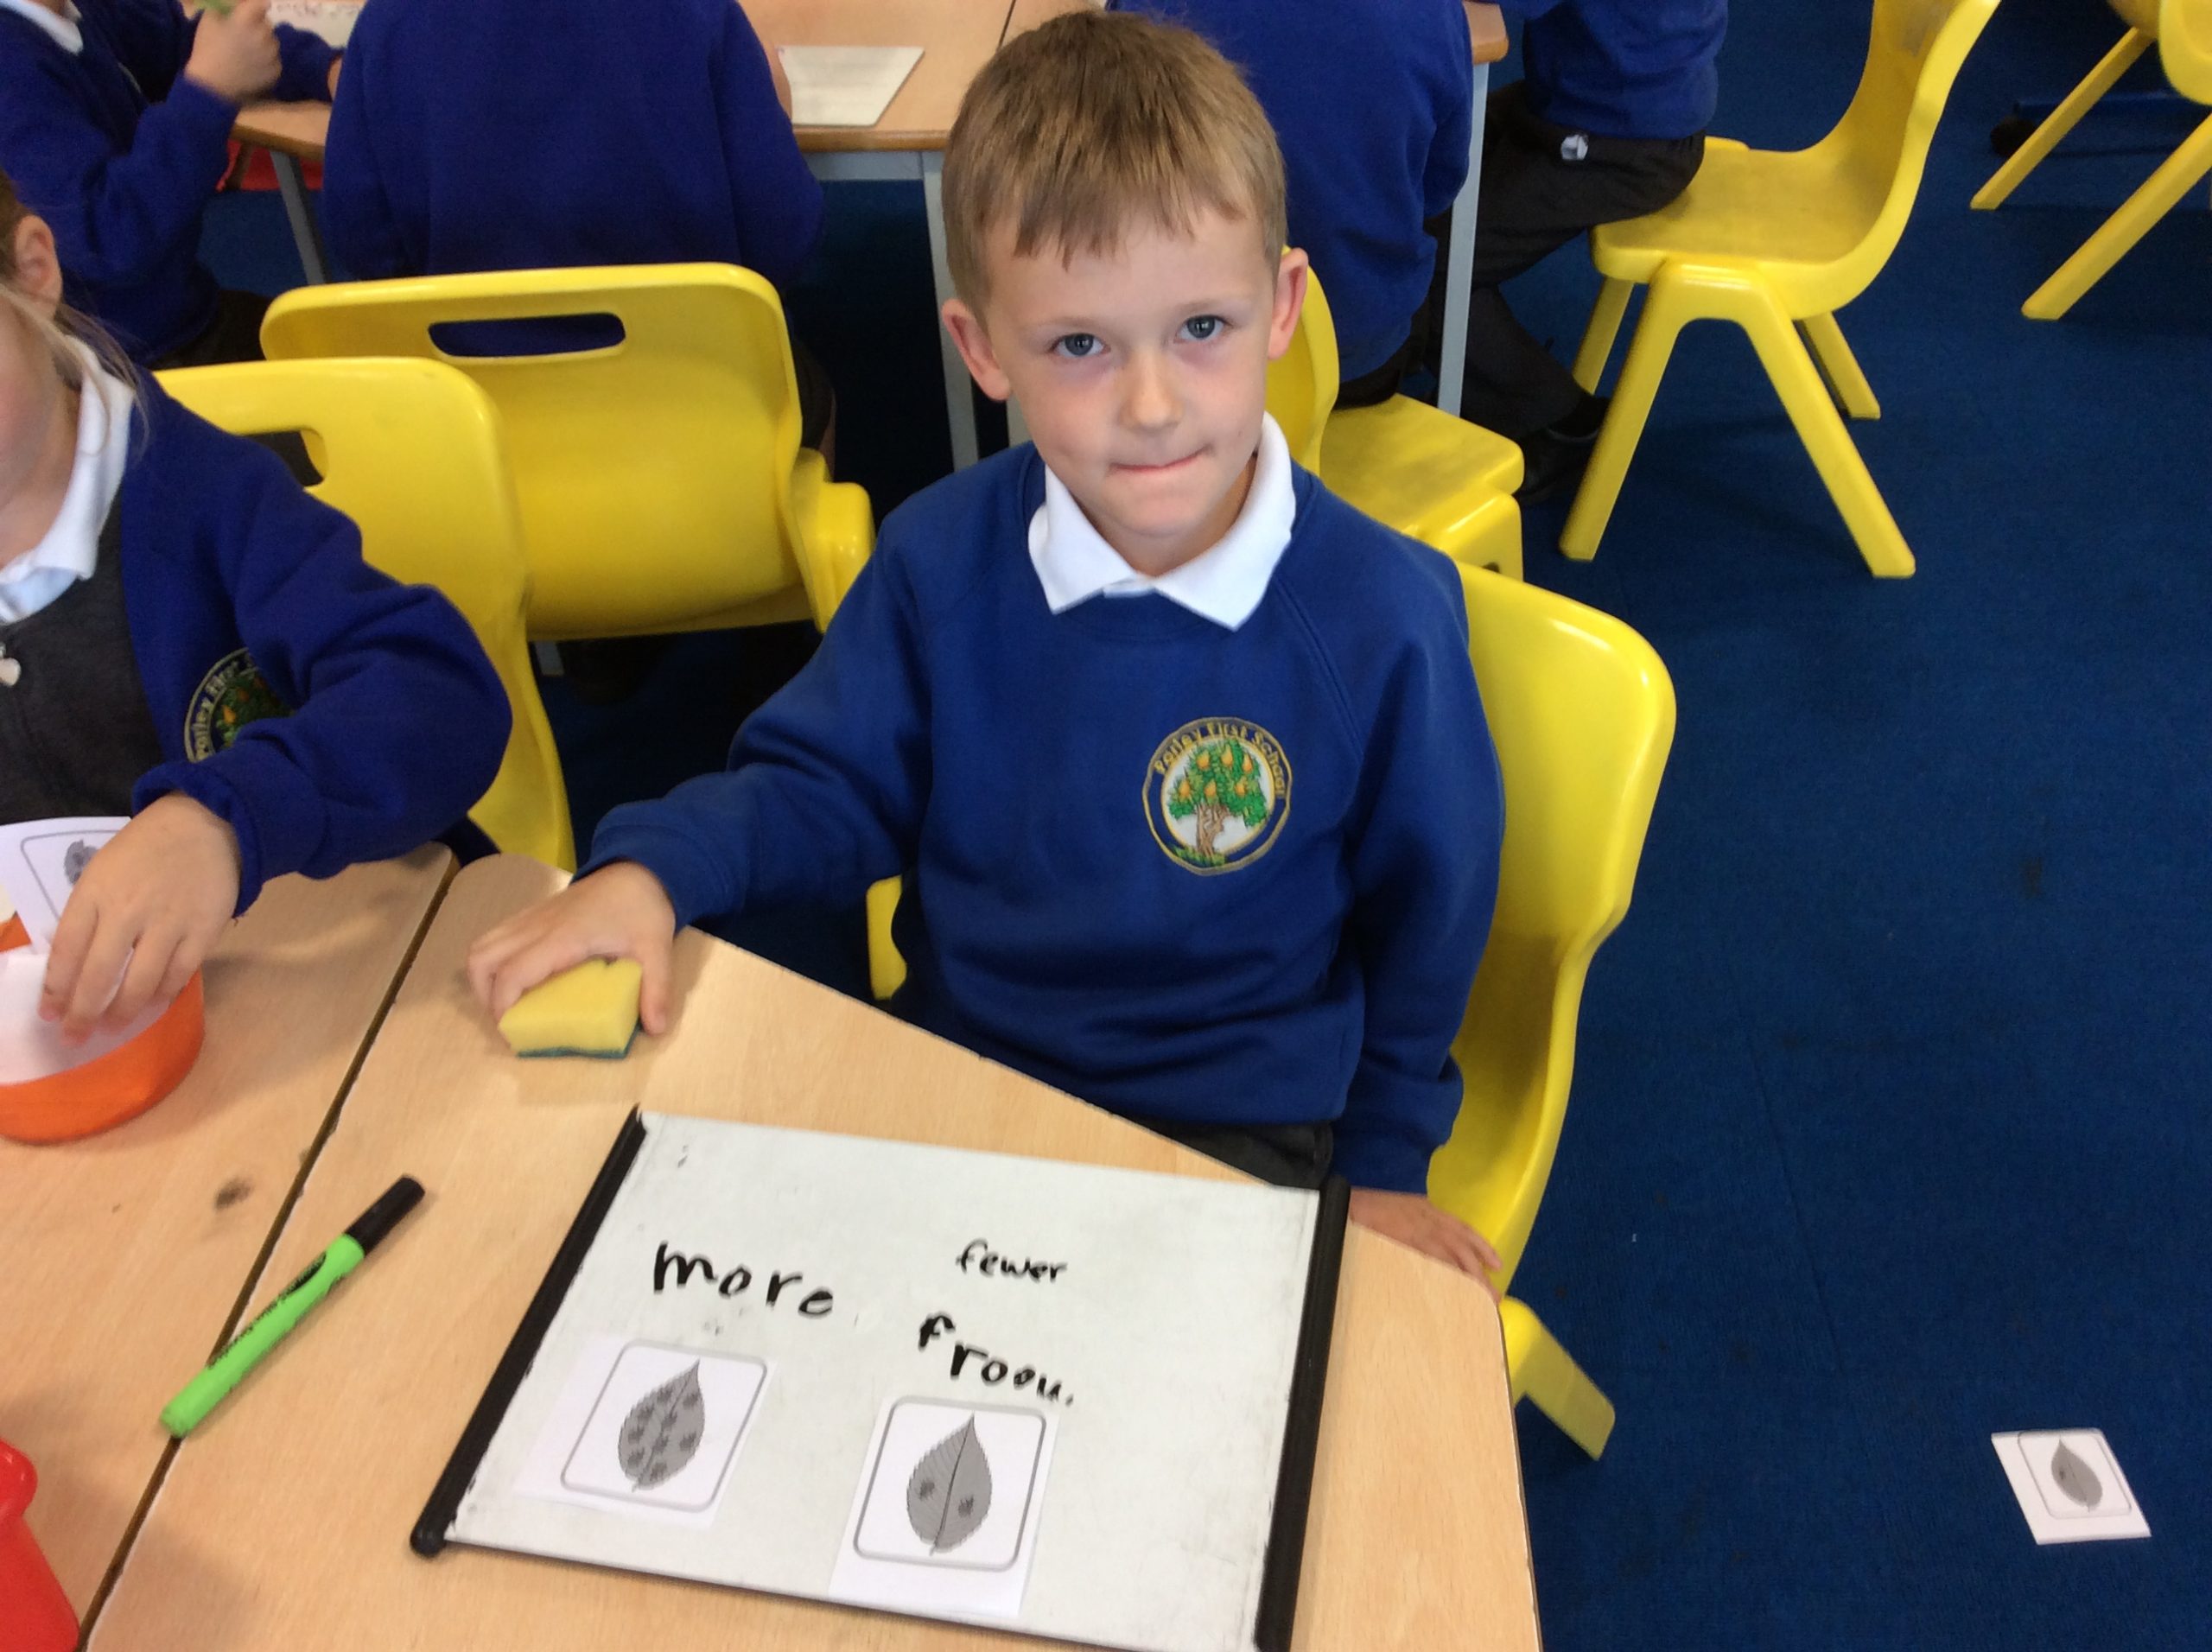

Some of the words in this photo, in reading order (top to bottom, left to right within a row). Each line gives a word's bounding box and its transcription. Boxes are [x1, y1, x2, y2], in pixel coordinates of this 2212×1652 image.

[1206, 721, 1249, 740] First
[1250, 730, 1287, 797] School
[653, 1241, 834, 1318] more
[955, 1238, 1068, 1281] fewer
